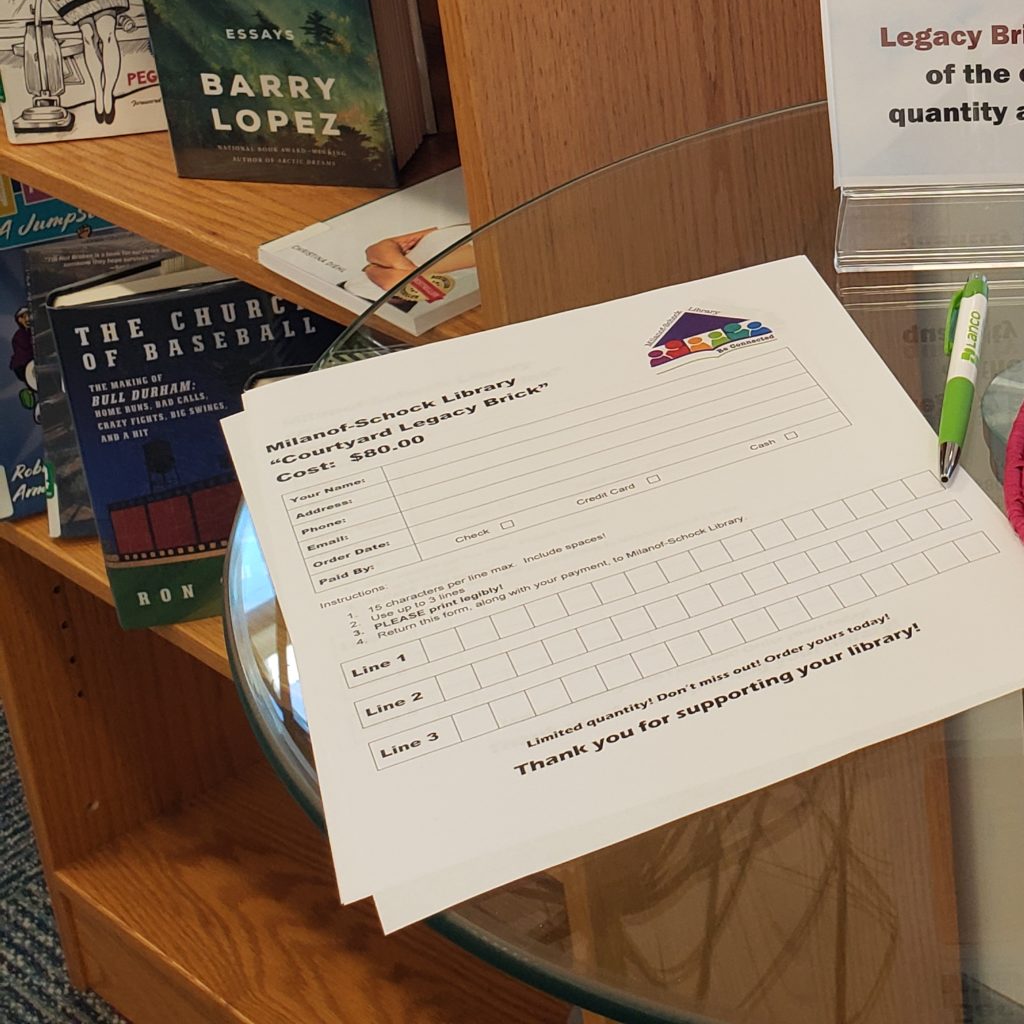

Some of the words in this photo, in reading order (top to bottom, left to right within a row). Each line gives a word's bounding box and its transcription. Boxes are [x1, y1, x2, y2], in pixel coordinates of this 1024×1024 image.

[225, 28, 295, 42] ESSAYS
[880, 27, 982, 51] Legacy
[925, 63, 955, 84] of
[962, 63, 1010, 84] the
[200, 72, 336, 101] BARRY
[210, 107, 342, 136] LOPEZ
[888, 101, 1008, 127] quantity
[74, 317, 144, 347] THE
[170, 295, 308, 332] CHURC
[82, 349, 118, 372] OF
[143, 316, 317, 362] BASEBALL
[88, 384, 108, 393] THE
[110, 376, 149, 390] MAKING
[151, 373, 163, 383] OF
[91, 388, 126, 408] BULL
[131, 380, 197, 402] DURHAM:
[265, 400, 436, 453] Milanof-Schock
[441, 377, 515, 403] Library
[398, 404, 476, 432] Legacy
[749, 439, 776, 450] Cash
[276, 461, 335, 482] Cost:
[349, 435, 424, 461] $80.00
[289, 491, 320, 502] Your
[323, 478, 365, 493] Name:
[576, 491, 608, 505] Credit
[609, 482, 635, 495] Card
[295, 499, 352, 519] Address:
[301, 518, 346, 535] Phone:
[454, 528, 490, 543] Check
[306, 535, 348, 551] Email:
[312, 552, 350, 567] Order
[354, 541, 390, 555] Date:
[318, 571, 349, 585] Paid
[352, 565, 374, 575] By:
[137, 583, 195, 607] RON
[319, 585, 388, 609] Instructions:
[374, 609, 425, 630] PLEASE
[428, 599, 458, 614] print
[459, 583, 503, 602] legibly!
[351, 660, 390, 677] Line
[396, 653, 405, 661] 1
[526, 722, 583, 747] Limited
[586, 697, 653, 727] quantity!
[698, 672, 729, 686] miss
[732, 659, 761, 674] out!
[764, 645, 803, 662] Order
[806, 630, 844, 650] yours
[846, 613, 890, 633] today!
[365, 699, 405, 716] Line
[410, 691, 423, 702] 2
[513, 744, 588, 775] Thank
[591, 728, 634, 752] you
[638, 714, 669, 732] for
[676, 671, 794, 719] supporting
[796, 651, 842, 678] your
[847, 622, 920, 656] library!
[380, 740, 421, 758] Line
[426, 732, 439, 741] 3
